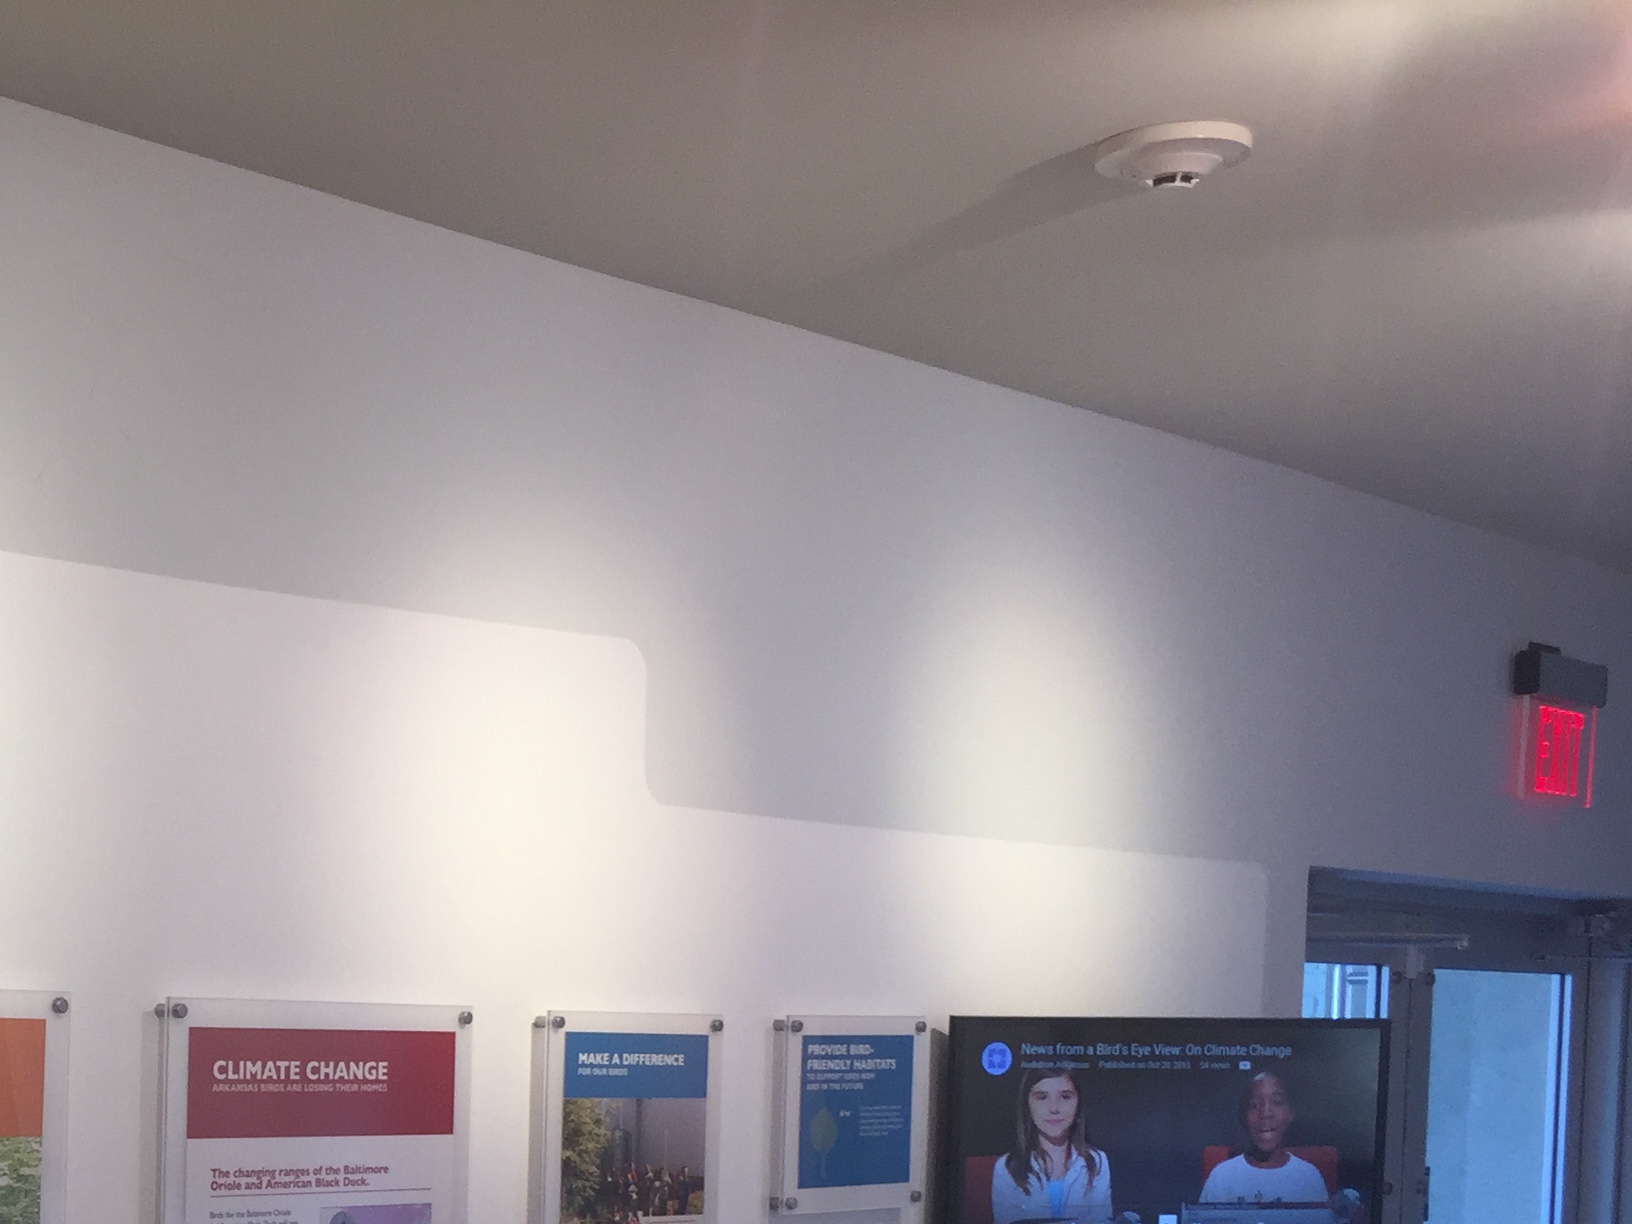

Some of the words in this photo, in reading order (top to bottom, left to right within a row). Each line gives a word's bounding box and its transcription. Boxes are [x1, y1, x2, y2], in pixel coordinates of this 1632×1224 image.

[1534, 704, 1585, 797] EXIT
[578, 1053, 610, 1065] MAKE
[611, 1053, 620, 1065] A
[623, 1053, 684, 1066] DIFFERENCE
[213, 1060, 300, 1080] CLIMATE
[306, 1061, 388, 1080] CHANGE
[210, 1168, 231, 1179] The
[233, 1167, 277, 1180] changing
[278, 1168, 310, 1179] ranges
[312, 1165, 323, 1176] of
[325, 1166, 341, 1176] the
[343, 1165, 389, 1175] Baltimore
